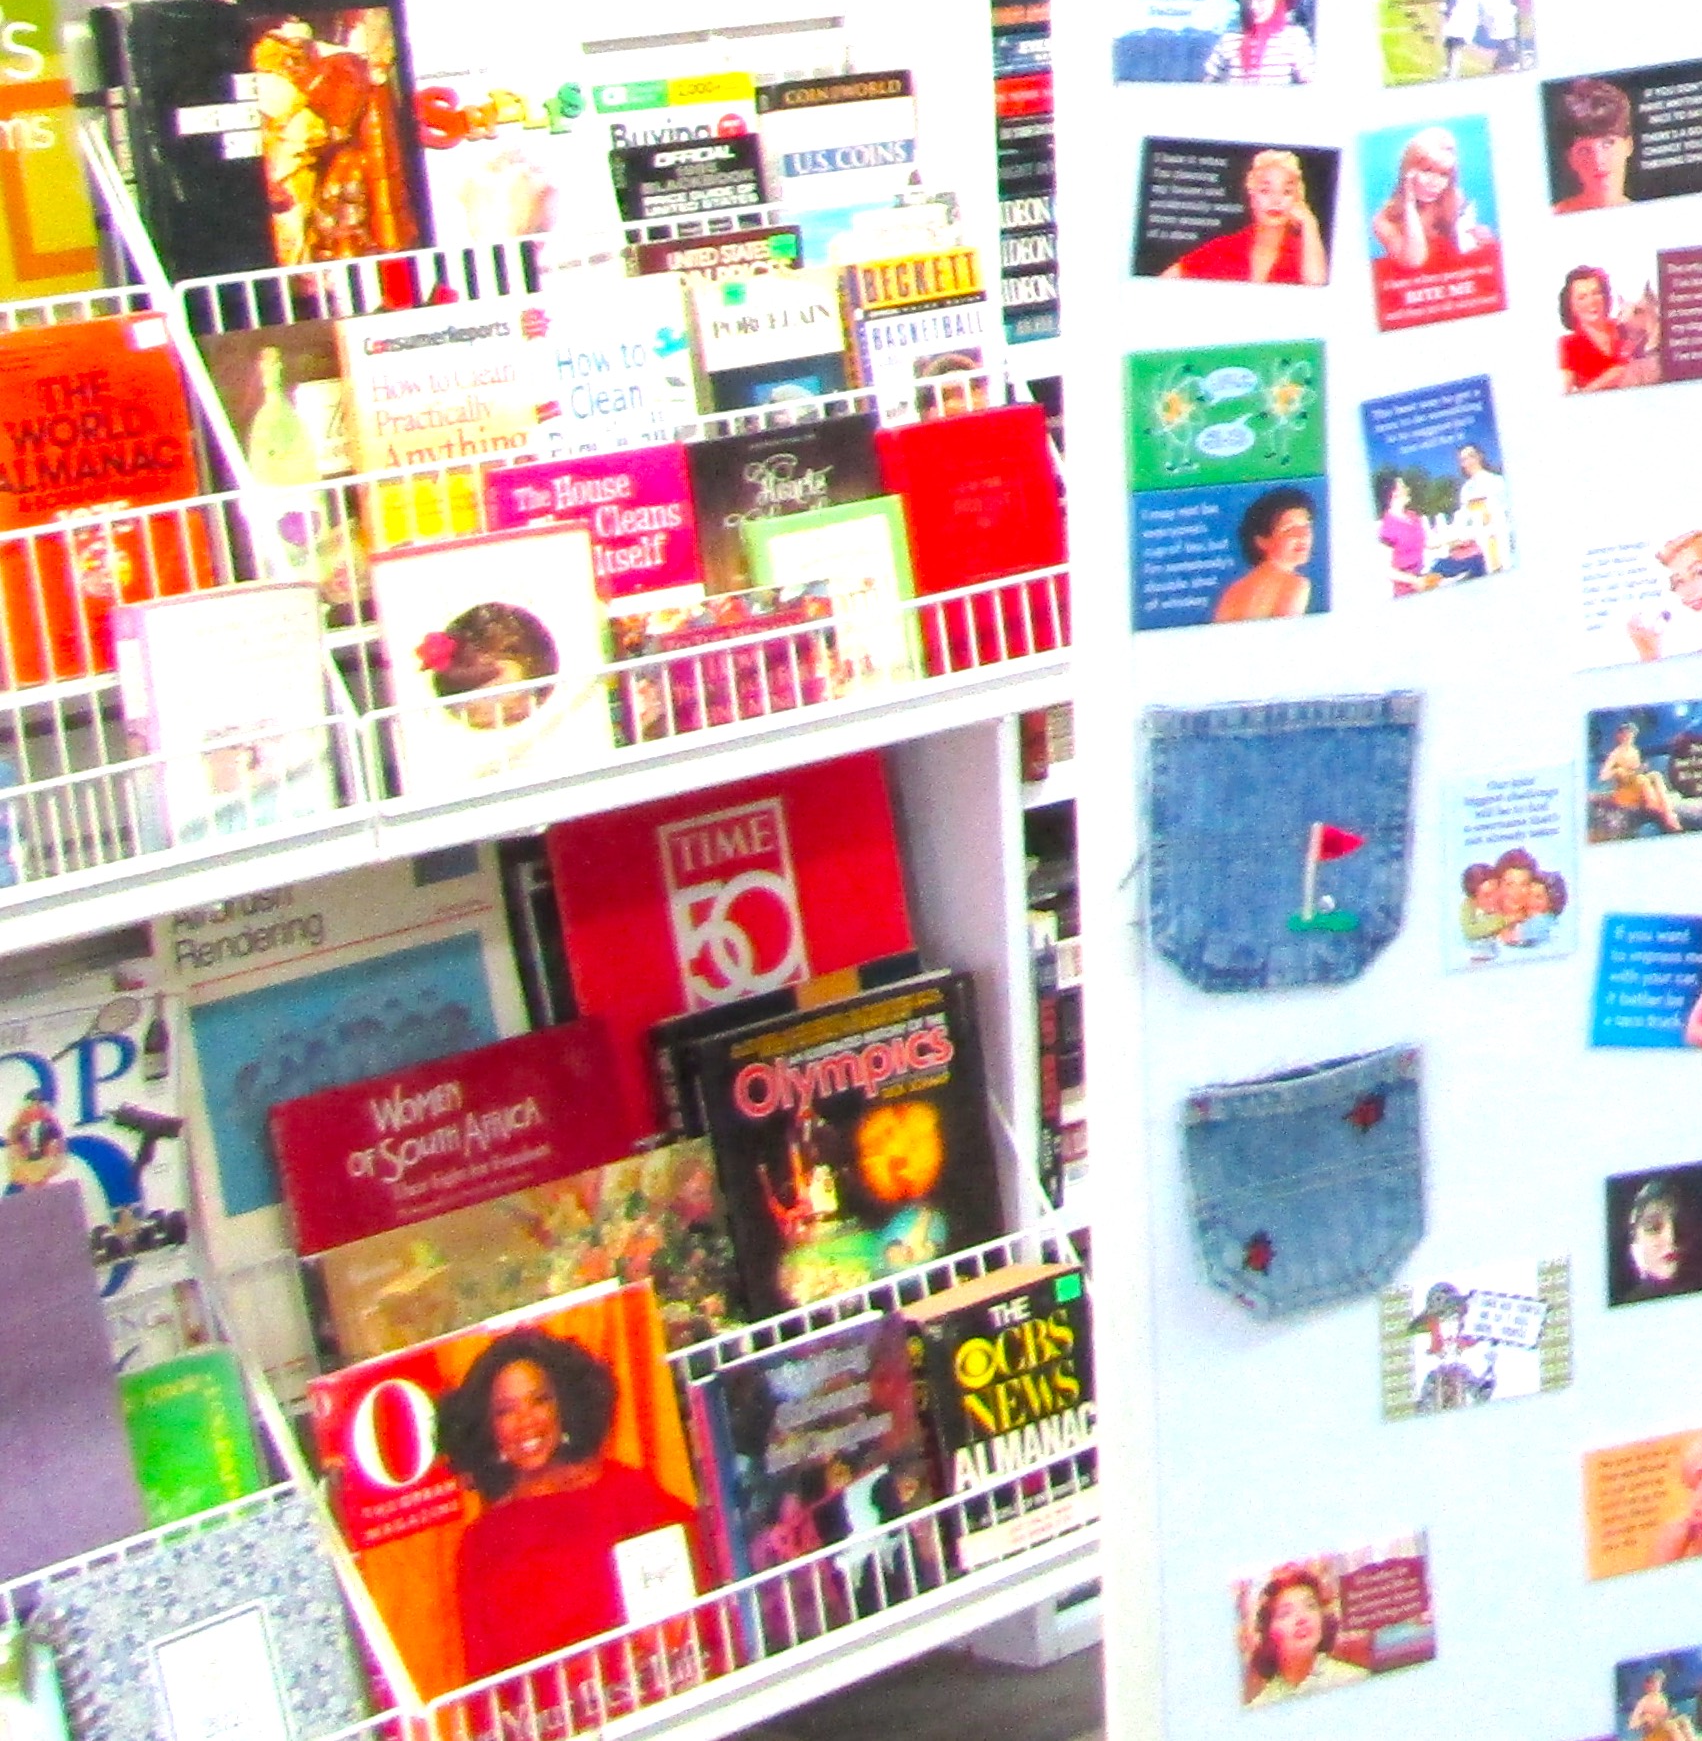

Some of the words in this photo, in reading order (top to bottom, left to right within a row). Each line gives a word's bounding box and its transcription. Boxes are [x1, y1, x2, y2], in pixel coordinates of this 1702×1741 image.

[783, 84, 824, 106] COIN
[653, 144, 737, 168] OFFICIAL
[834, 141, 908, 170] COINS
[666, 247, 719, 269] UNITED
[719, 243, 769, 264] STATES
[863, 250, 980, 304] BECKETT
[1403, 283, 1448, 306] BITE
[1449, 279, 1476, 300] ME
[870, 309, 984, 352] BASKETBALL
[555, 346, 615, 383] How
[619, 339, 646, 370] to
[41, 370, 110, 412] THE
[369, 371, 426, 406] How
[570, 381, 644, 422] Clean
[8, 406, 158, 451] WORLD
[376, 394, 496, 439] Practically
[552, 470, 631, 508] House
[594, 501, 683, 538] Cleans
[592, 534, 668, 577] Itself
[676, 814, 778, 873] TIME
[172, 910, 326, 969] Rendering
[671, 868, 800, 1010] 50
[732, 1022, 955, 1120] Olympics
[986, 1294, 1032, 1329] THE
[994, 1313, 1076, 1374] CBS
[961, 1367, 1081, 1435] NEWS
[352, 1376, 438, 1488] O
[953, 1400, 1098, 1494] ALMANAC
